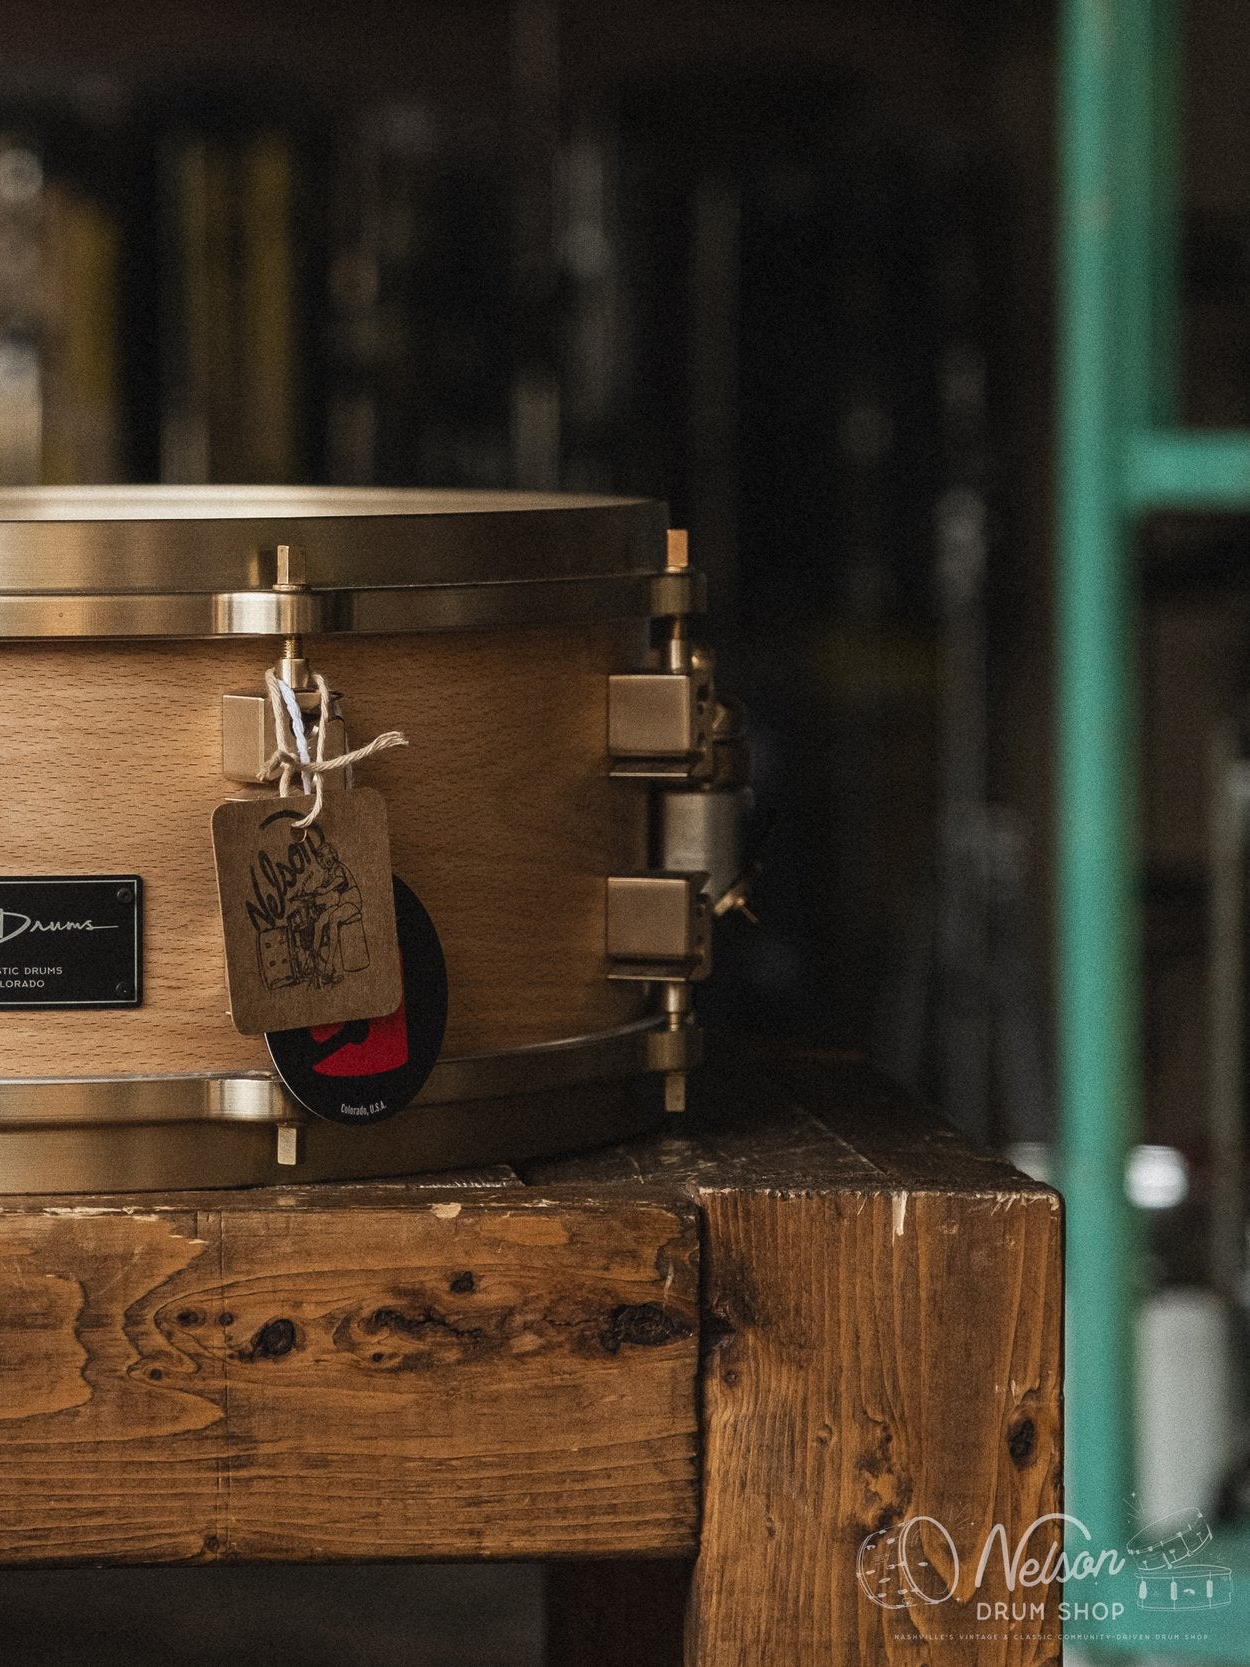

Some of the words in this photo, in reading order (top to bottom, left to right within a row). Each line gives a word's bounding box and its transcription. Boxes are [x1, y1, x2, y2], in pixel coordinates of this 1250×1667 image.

[24, 966, 63, 975] DRUMS
[340, 1103, 369, 1116] Colorado,
[369, 1100, 387, 1114] U.S.A.
